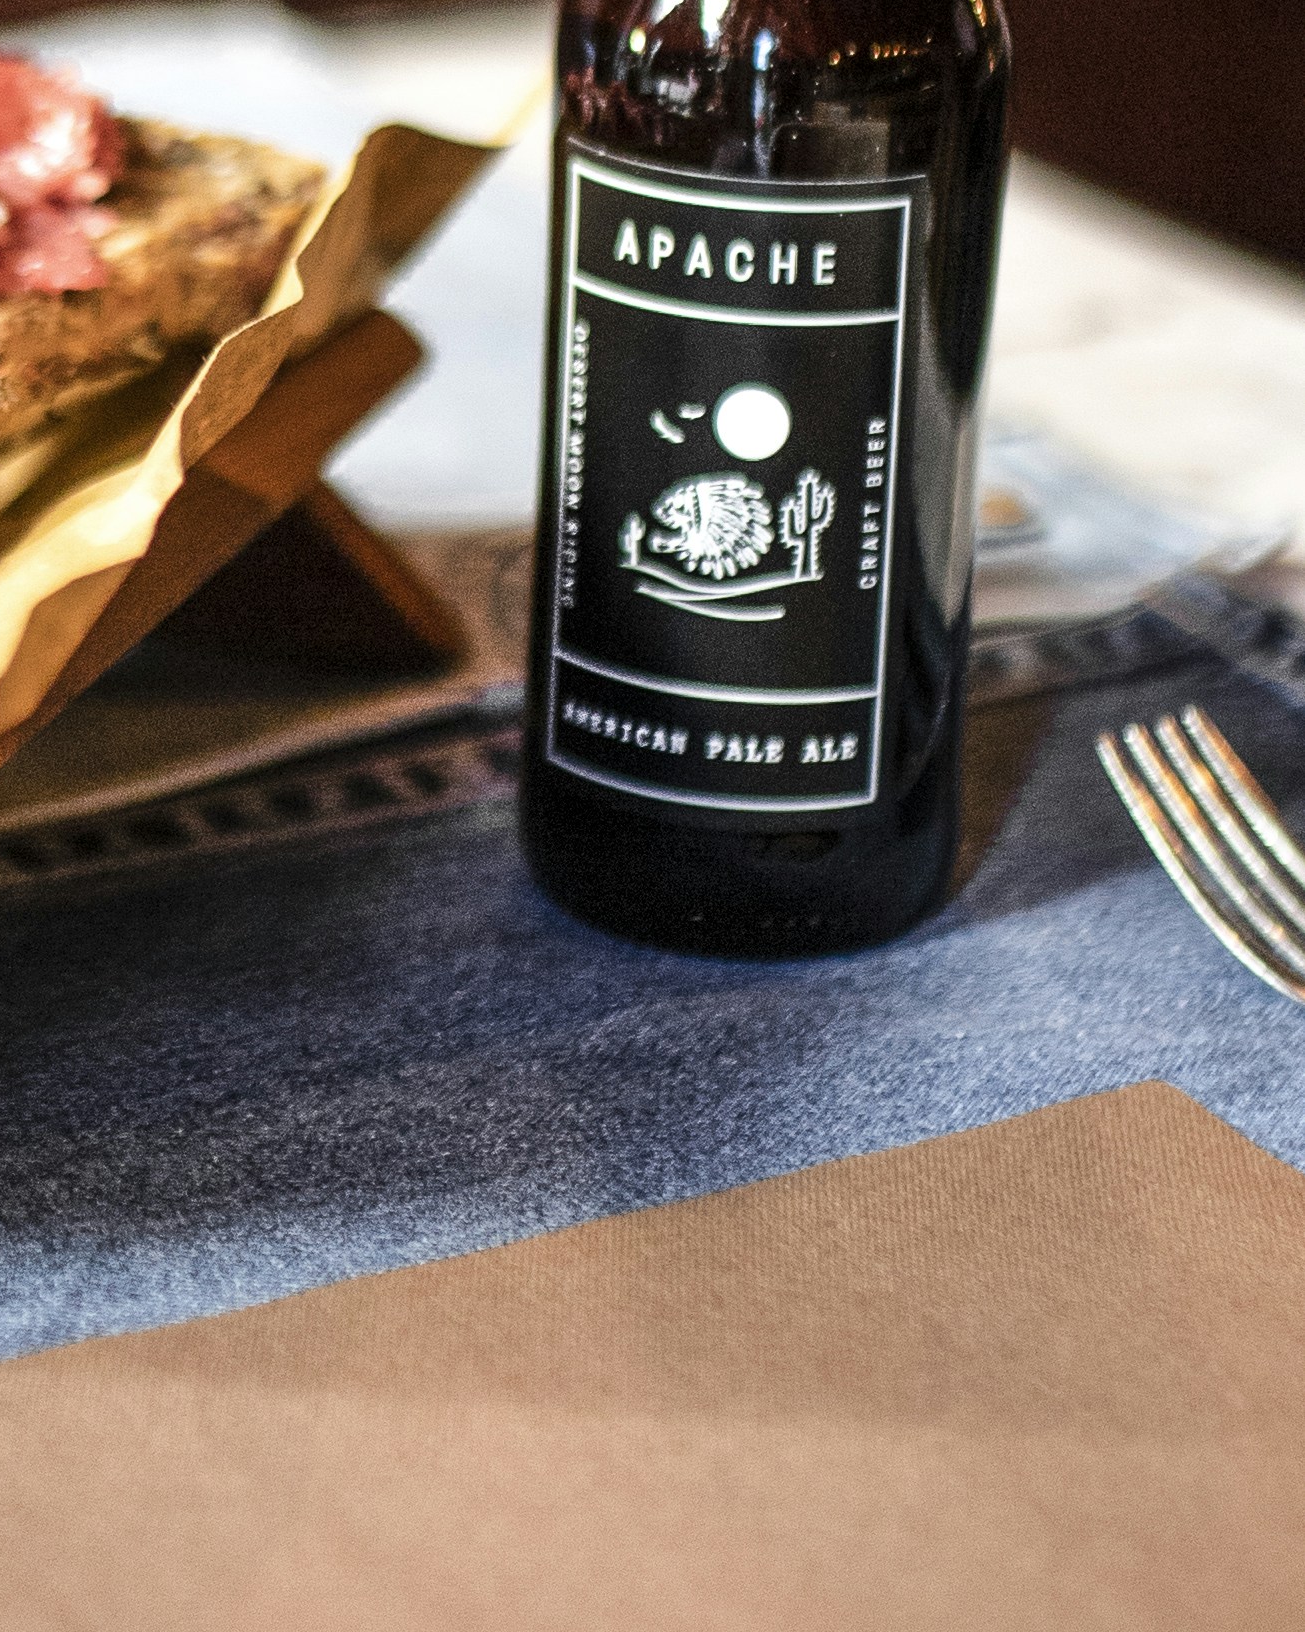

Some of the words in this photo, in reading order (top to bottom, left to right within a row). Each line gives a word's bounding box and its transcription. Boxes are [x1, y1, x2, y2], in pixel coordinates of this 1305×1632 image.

[614, 218, 837, 286] APACHE
[564, 429, 585, 510] MOON
[865, 418, 886, 488] BEER
[858, 500, 881, 590] CRAFT
[562, 699, 689, 755] AMERICAN
[704, 730, 785, 764] PALE
[800, 733, 859, 764] ALE
